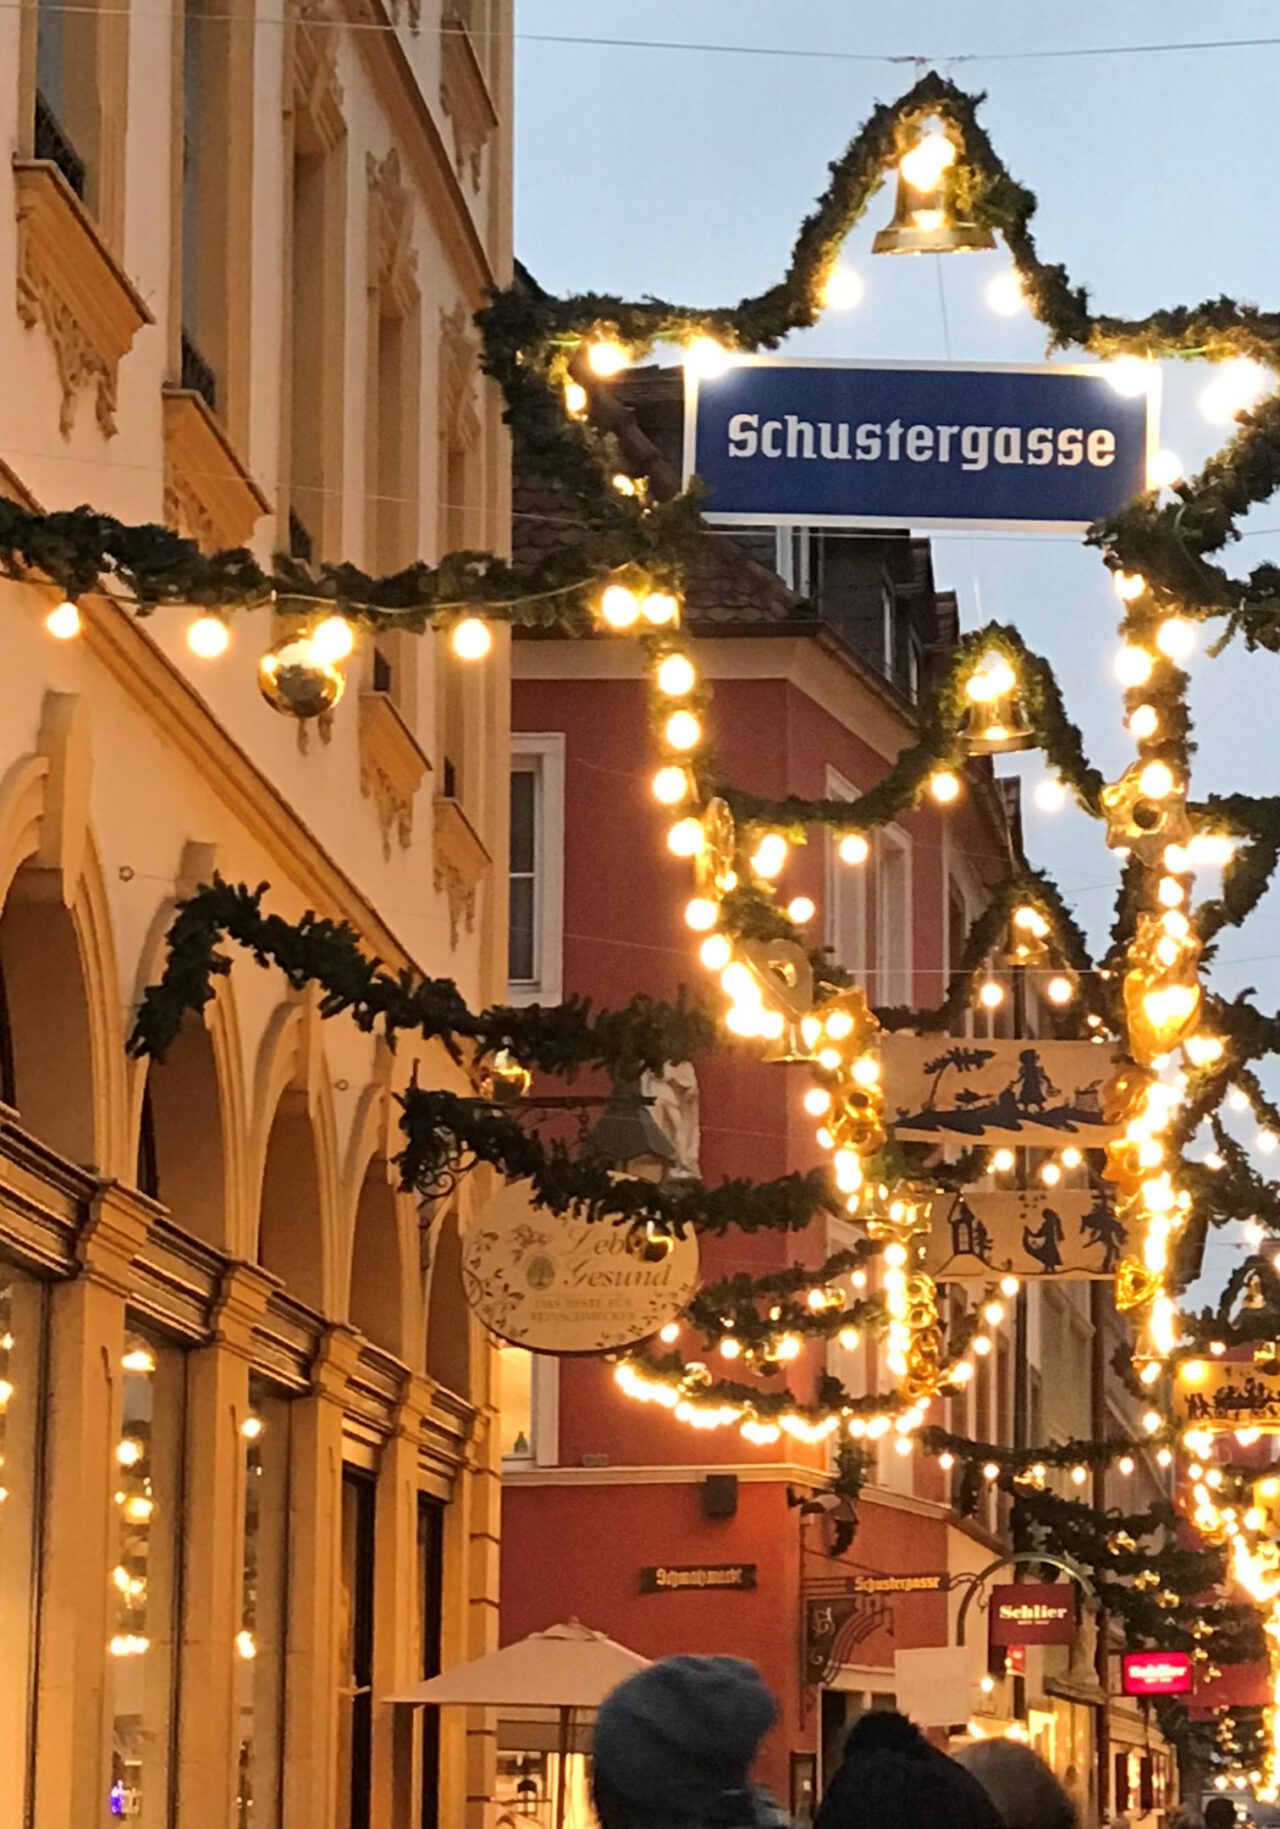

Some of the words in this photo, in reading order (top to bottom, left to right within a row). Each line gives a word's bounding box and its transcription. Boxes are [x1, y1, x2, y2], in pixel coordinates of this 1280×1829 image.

[728, 413, 1116, 471] Schustergasse
[559, 1226, 636, 1256] Leb
[563, 1259, 672, 1288] Gesund
[999, 1604, 1068, 1619] Schlier
